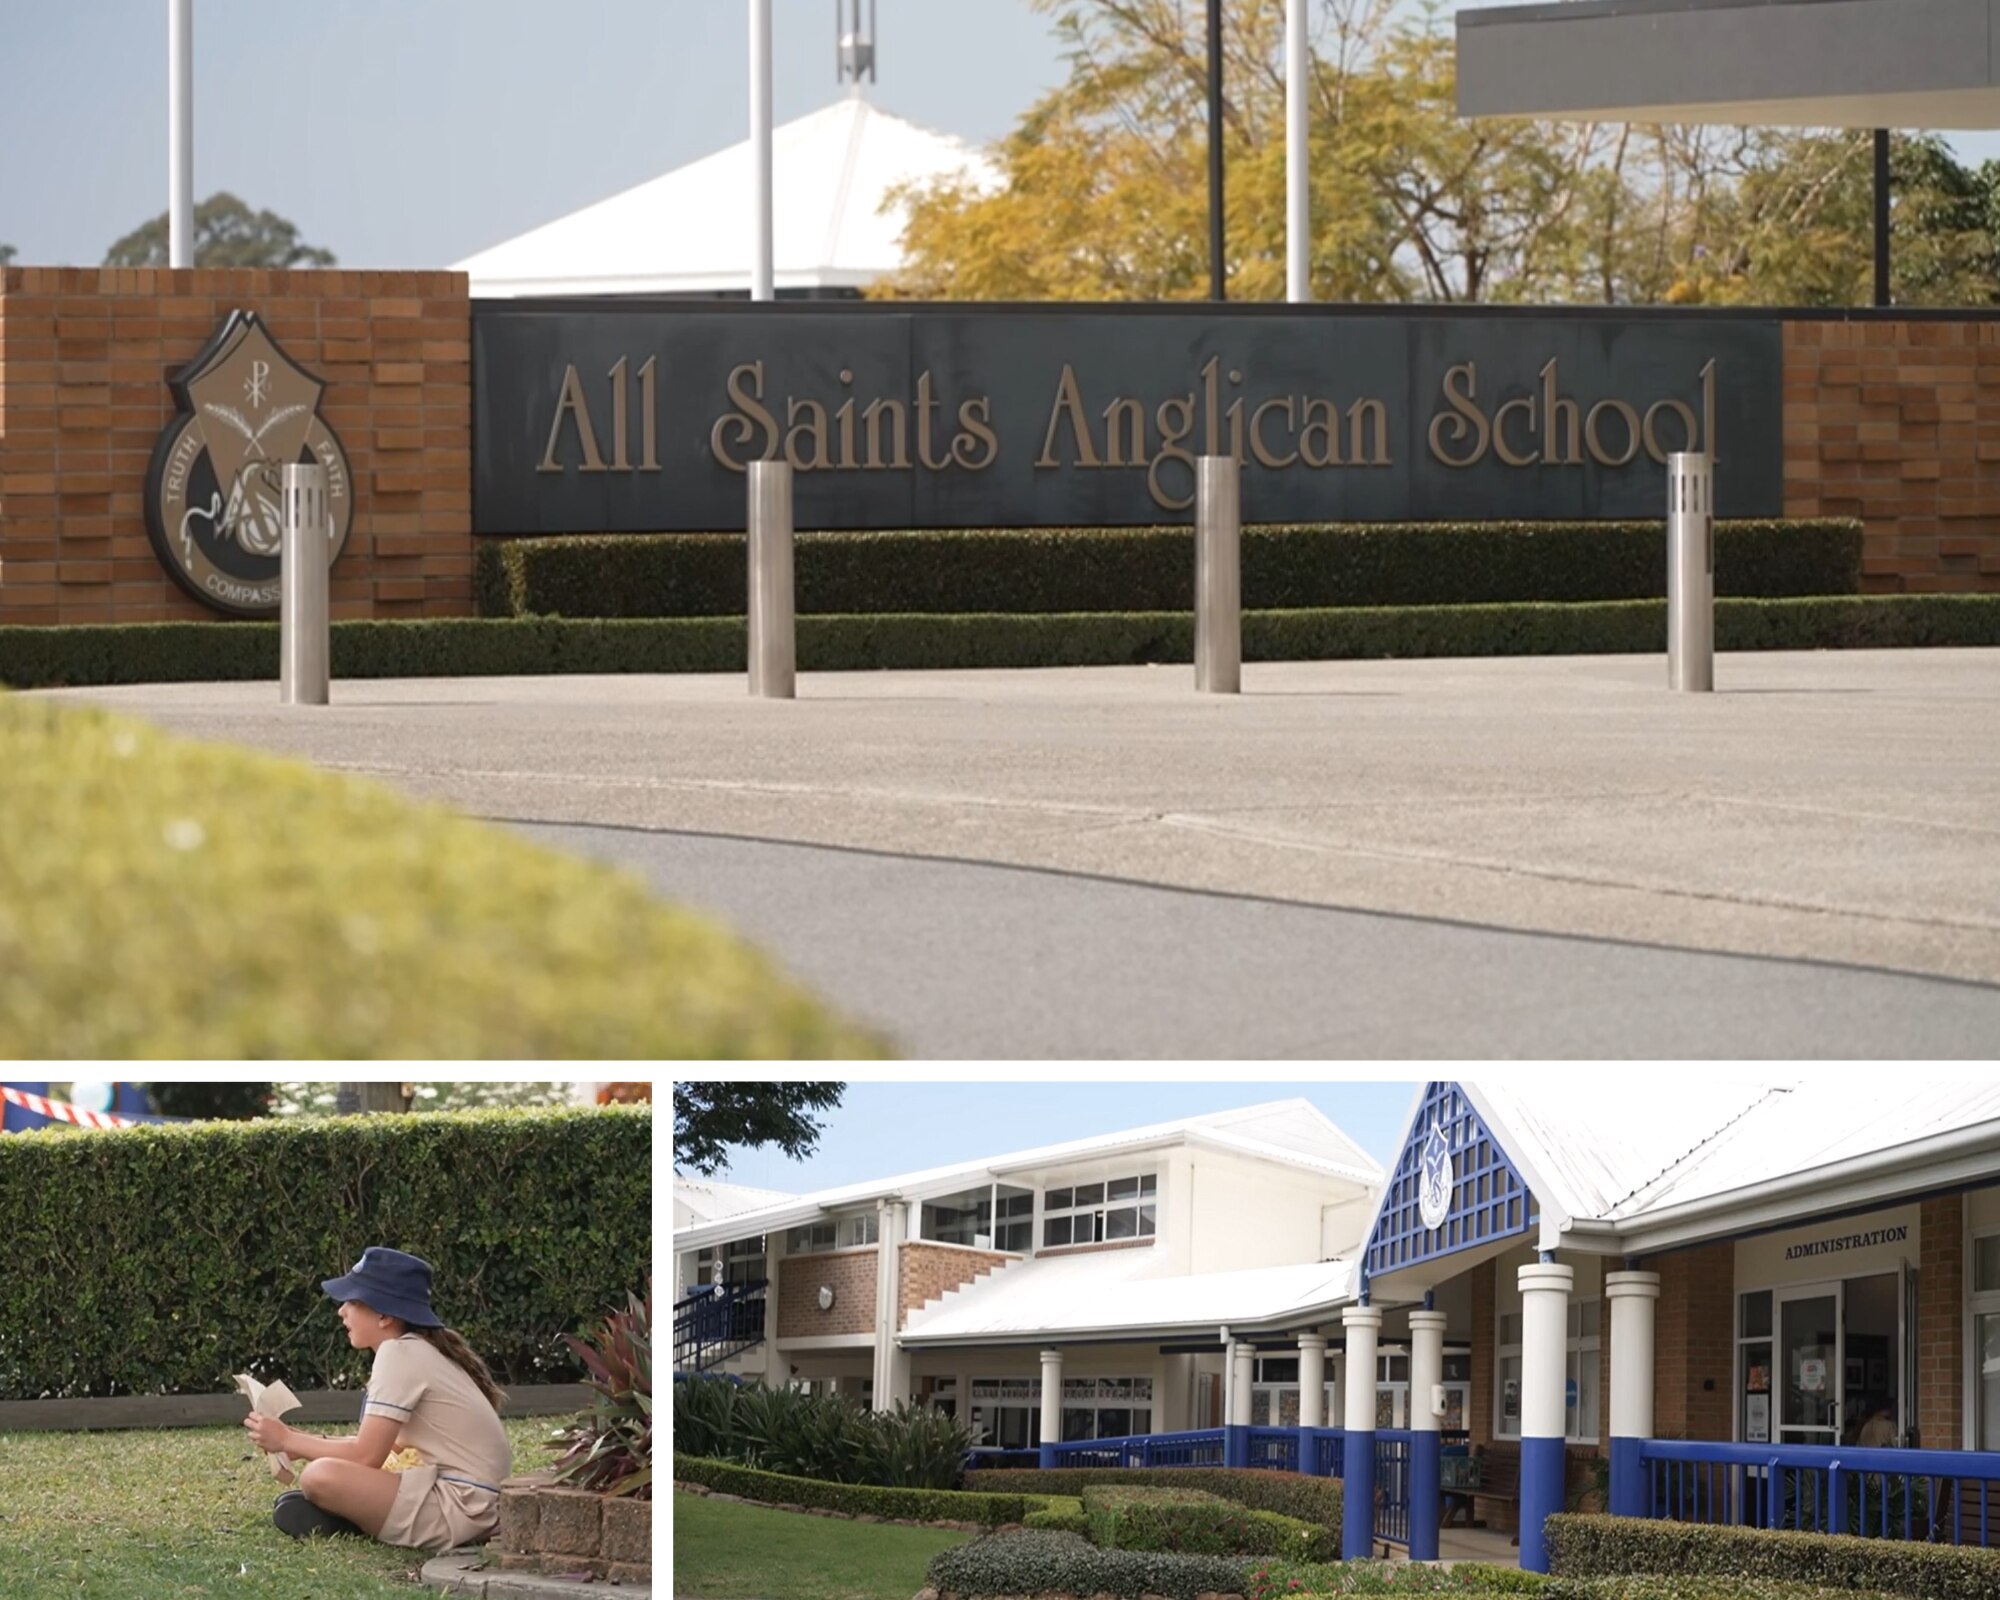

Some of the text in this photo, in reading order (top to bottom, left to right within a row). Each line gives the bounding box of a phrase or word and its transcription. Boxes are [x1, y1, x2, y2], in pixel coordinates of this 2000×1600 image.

[535, 354, 1721, 511] All Saints Anglican School
[167, 435, 197, 504] TRUTH
[317, 440, 344, 497] FAITH
[206, 574, 281, 603] COMPASS
[1785, 1225, 1909, 1261] ADMINISTRATION
